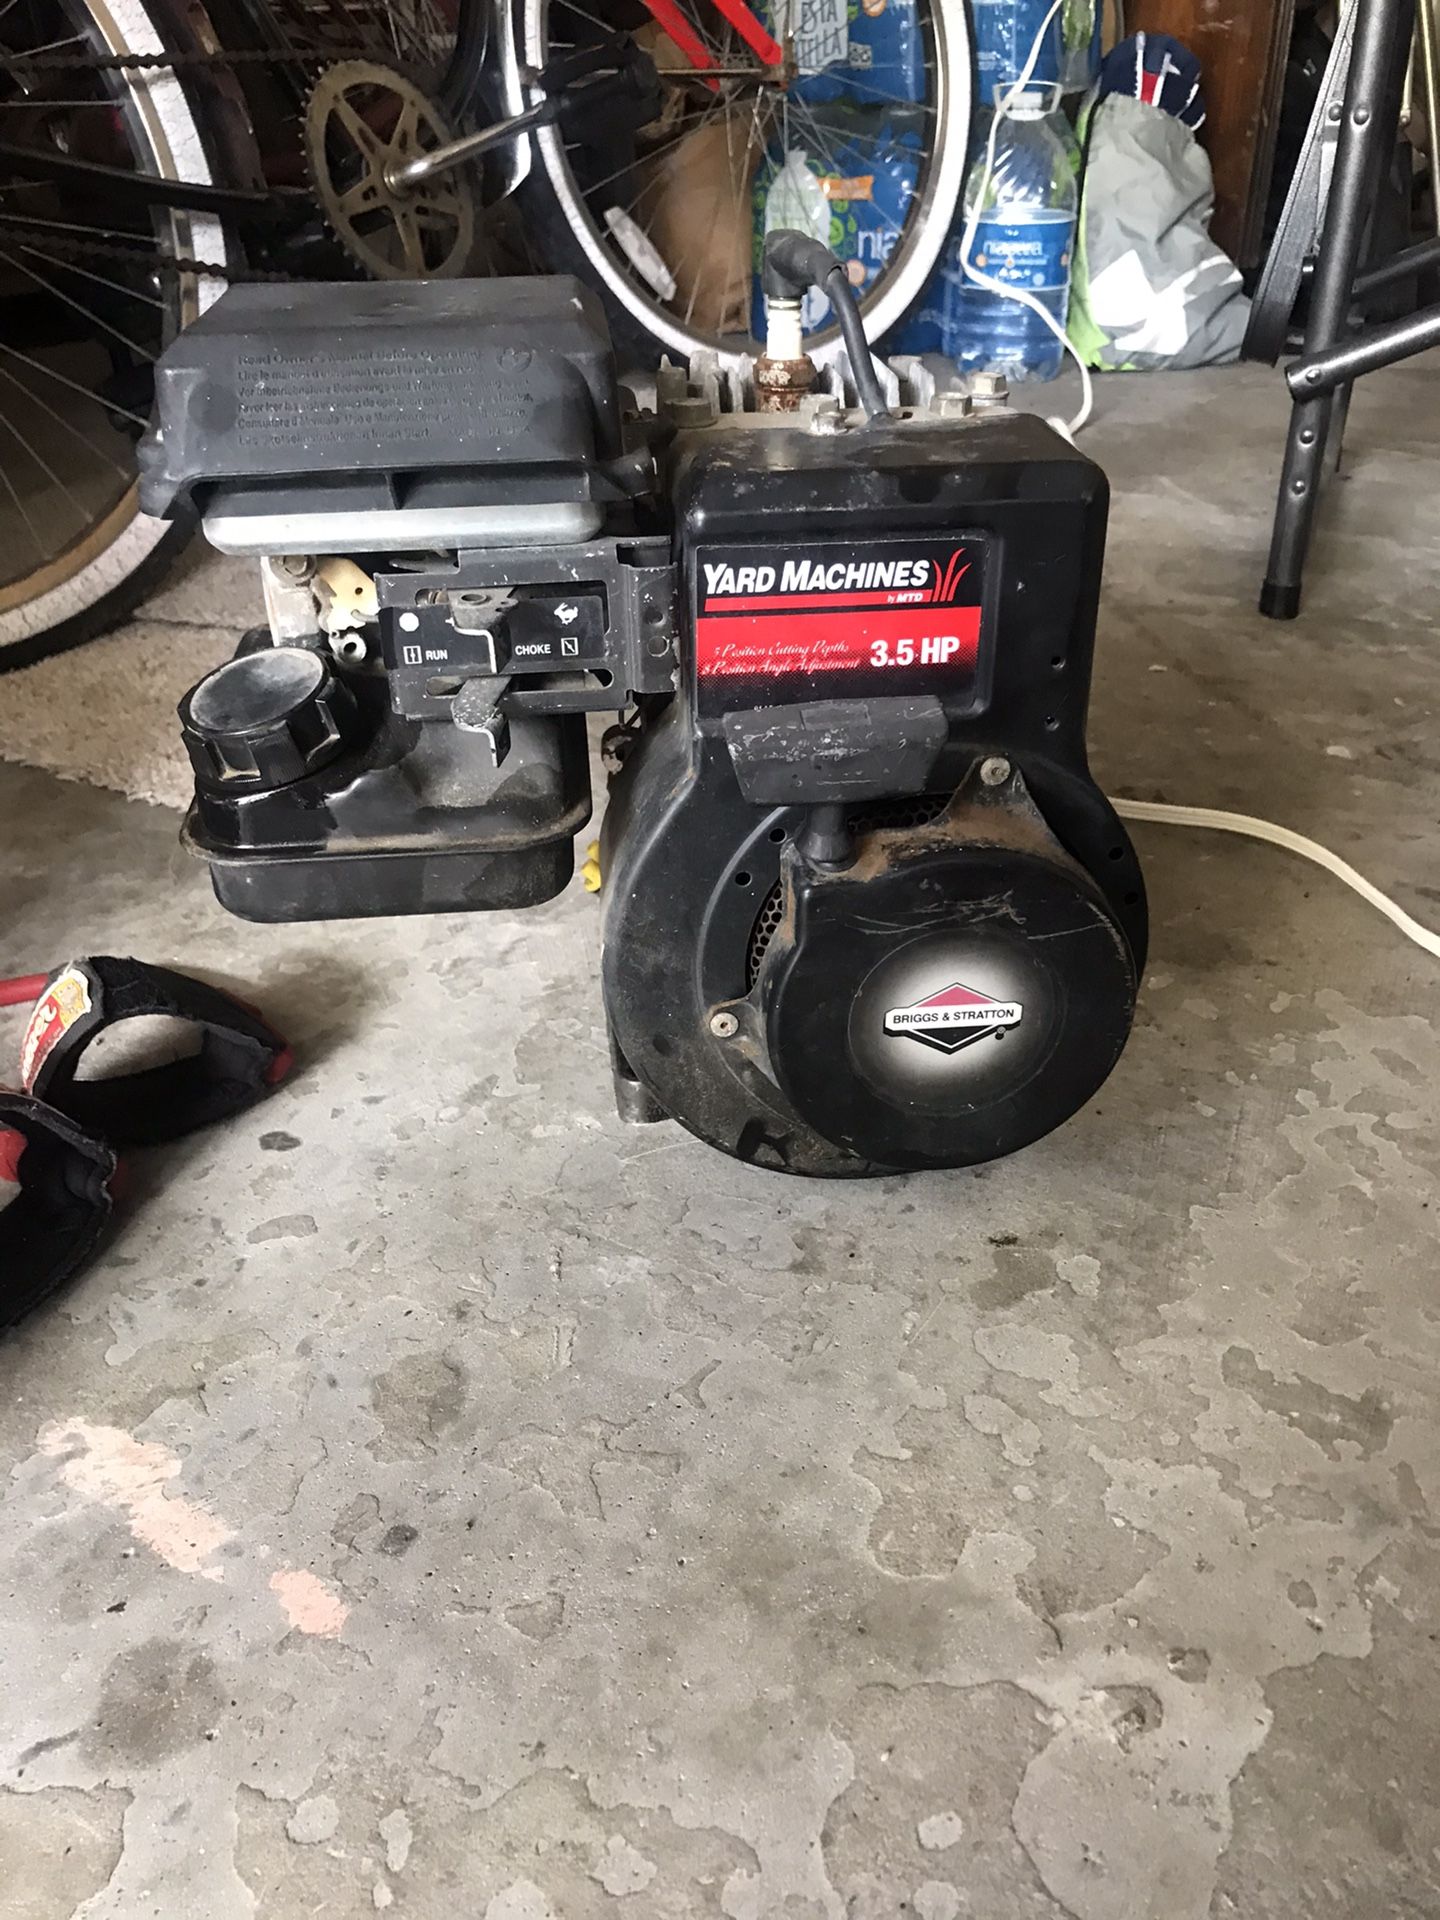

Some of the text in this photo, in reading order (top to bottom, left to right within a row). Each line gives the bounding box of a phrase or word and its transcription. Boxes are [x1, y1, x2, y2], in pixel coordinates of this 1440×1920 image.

[238, 353, 271, 365] Read
[703, 559, 930, 595] YARD MACHINES
[896, 593, 923, 603] MTD
[425, 644, 551, 661] RUN CHOKE
[870, 635, 960, 667] 3.5 HP
[893, 1009, 1015, 1024] BRIGGS & STRATTON
